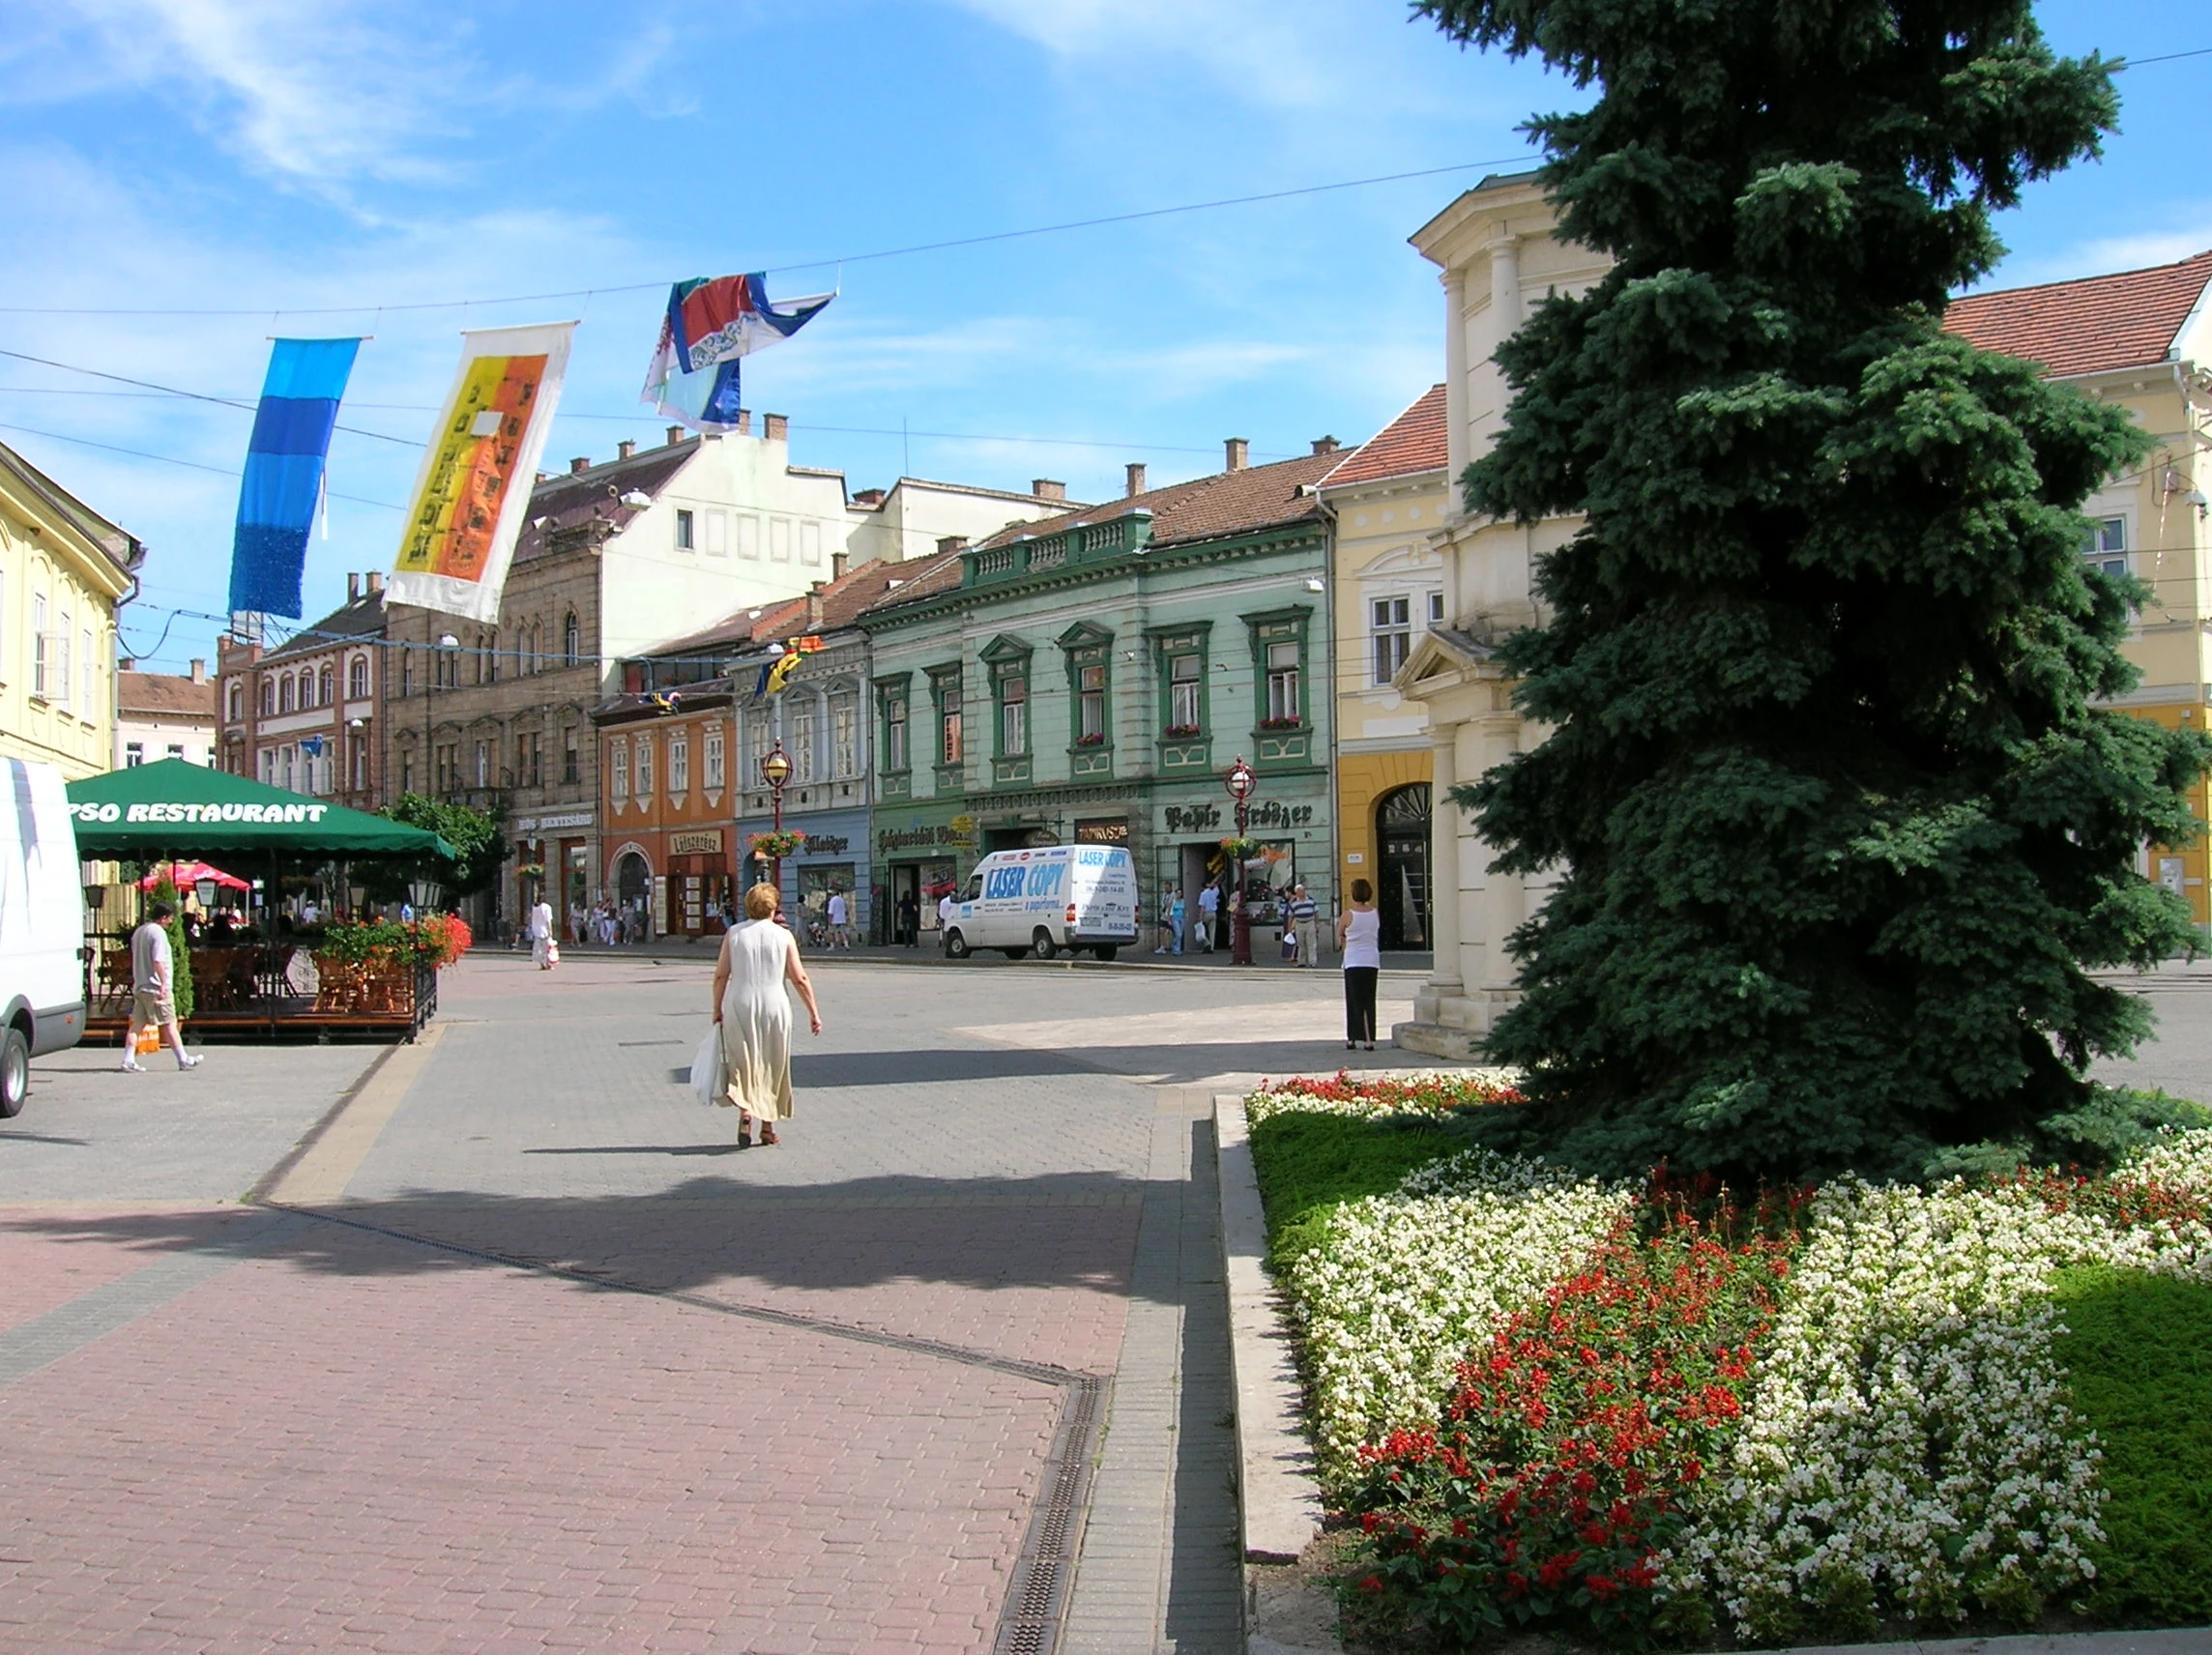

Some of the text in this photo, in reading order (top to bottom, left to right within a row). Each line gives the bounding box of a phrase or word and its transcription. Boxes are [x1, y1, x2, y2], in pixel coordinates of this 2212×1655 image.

[127, 803, 327, 822] RESTAURANT
[1079, 851, 1127, 867] LASER COPY
[985, 862, 1066, 900] LASER COPY
